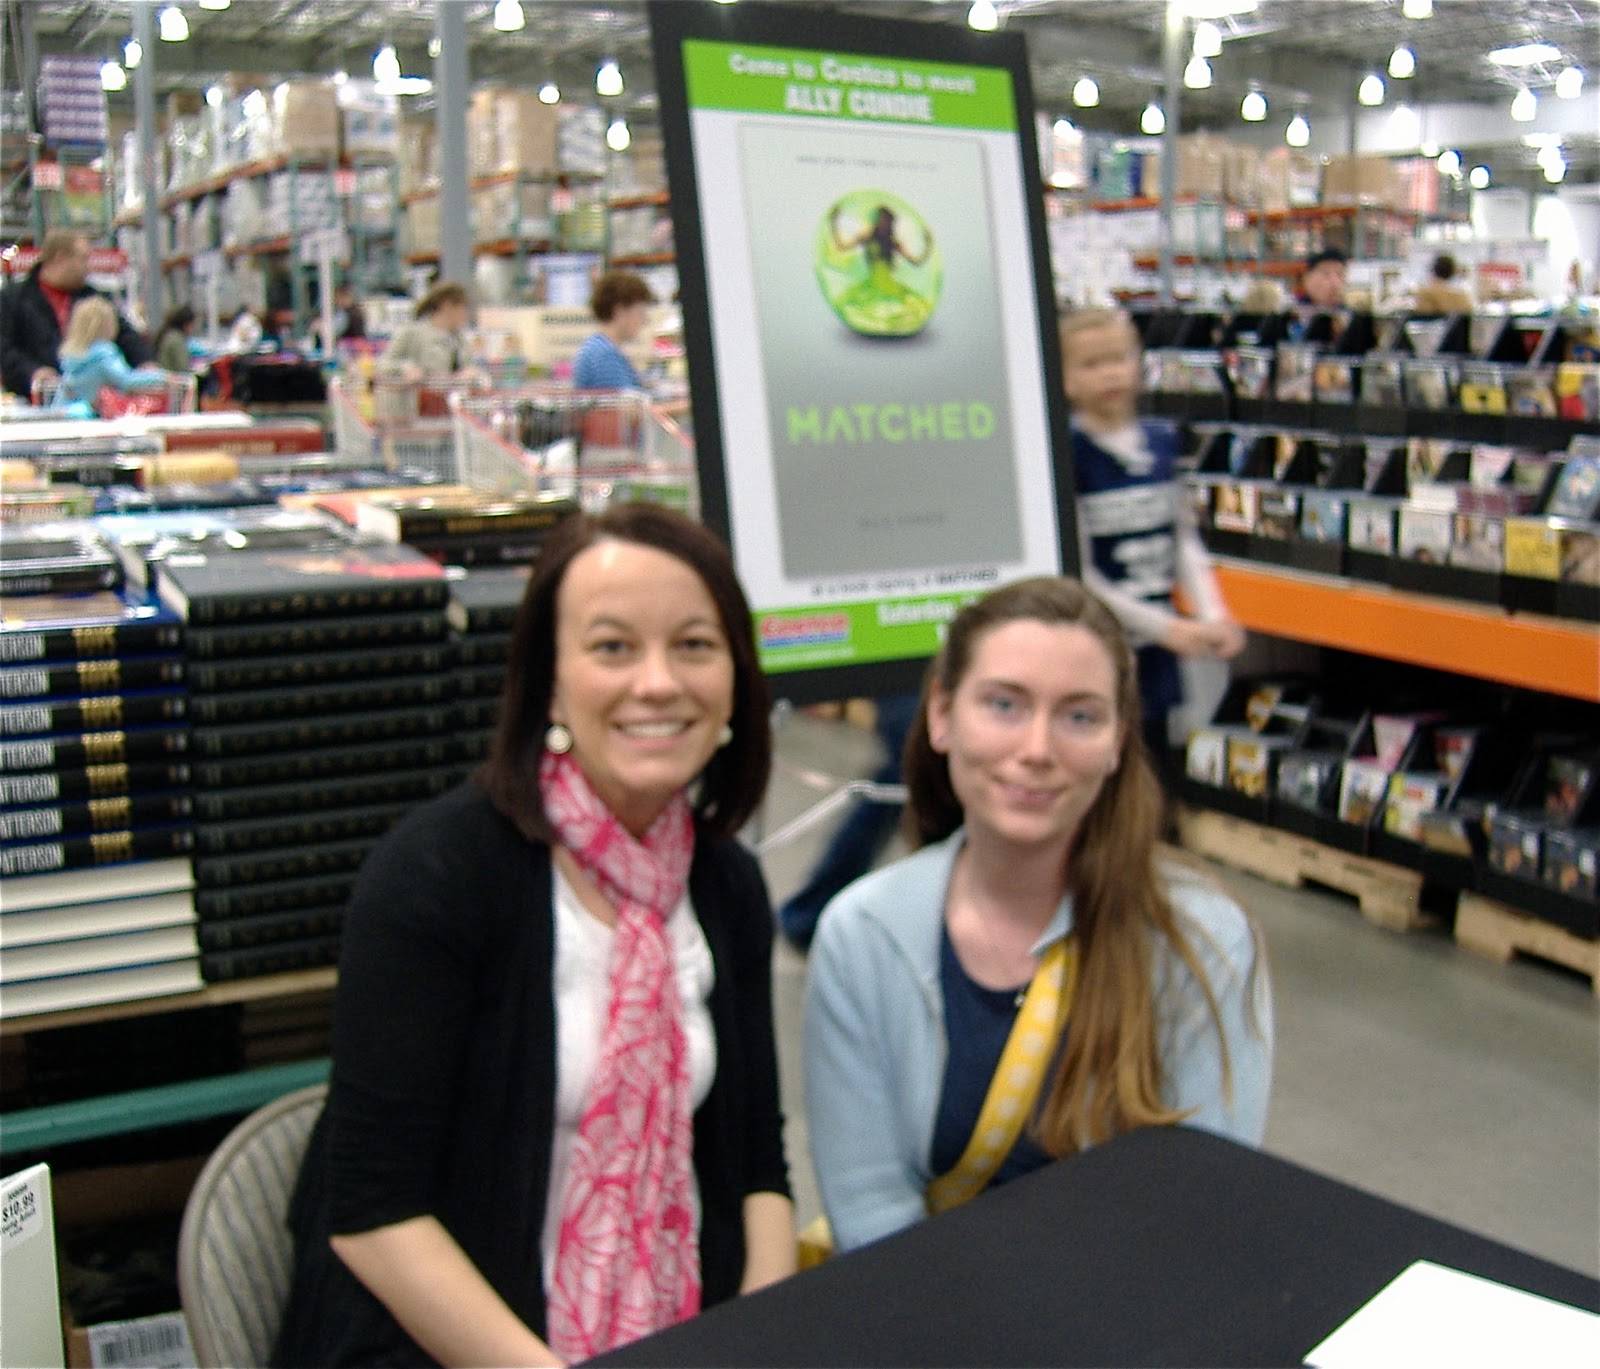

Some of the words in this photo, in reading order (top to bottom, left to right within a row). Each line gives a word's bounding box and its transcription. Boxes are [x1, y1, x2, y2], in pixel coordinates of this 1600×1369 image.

[728, 53, 788, 77] Come
[793, 59, 816, 80] to
[820, 57, 897, 88] Costco
[901, 71, 923, 90] to
[927, 75, 976, 94] meet
[785, 84, 842, 114] ALLY
[848, 88, 933, 122] CONDIE
[786, 402, 997, 445] MATCHED
